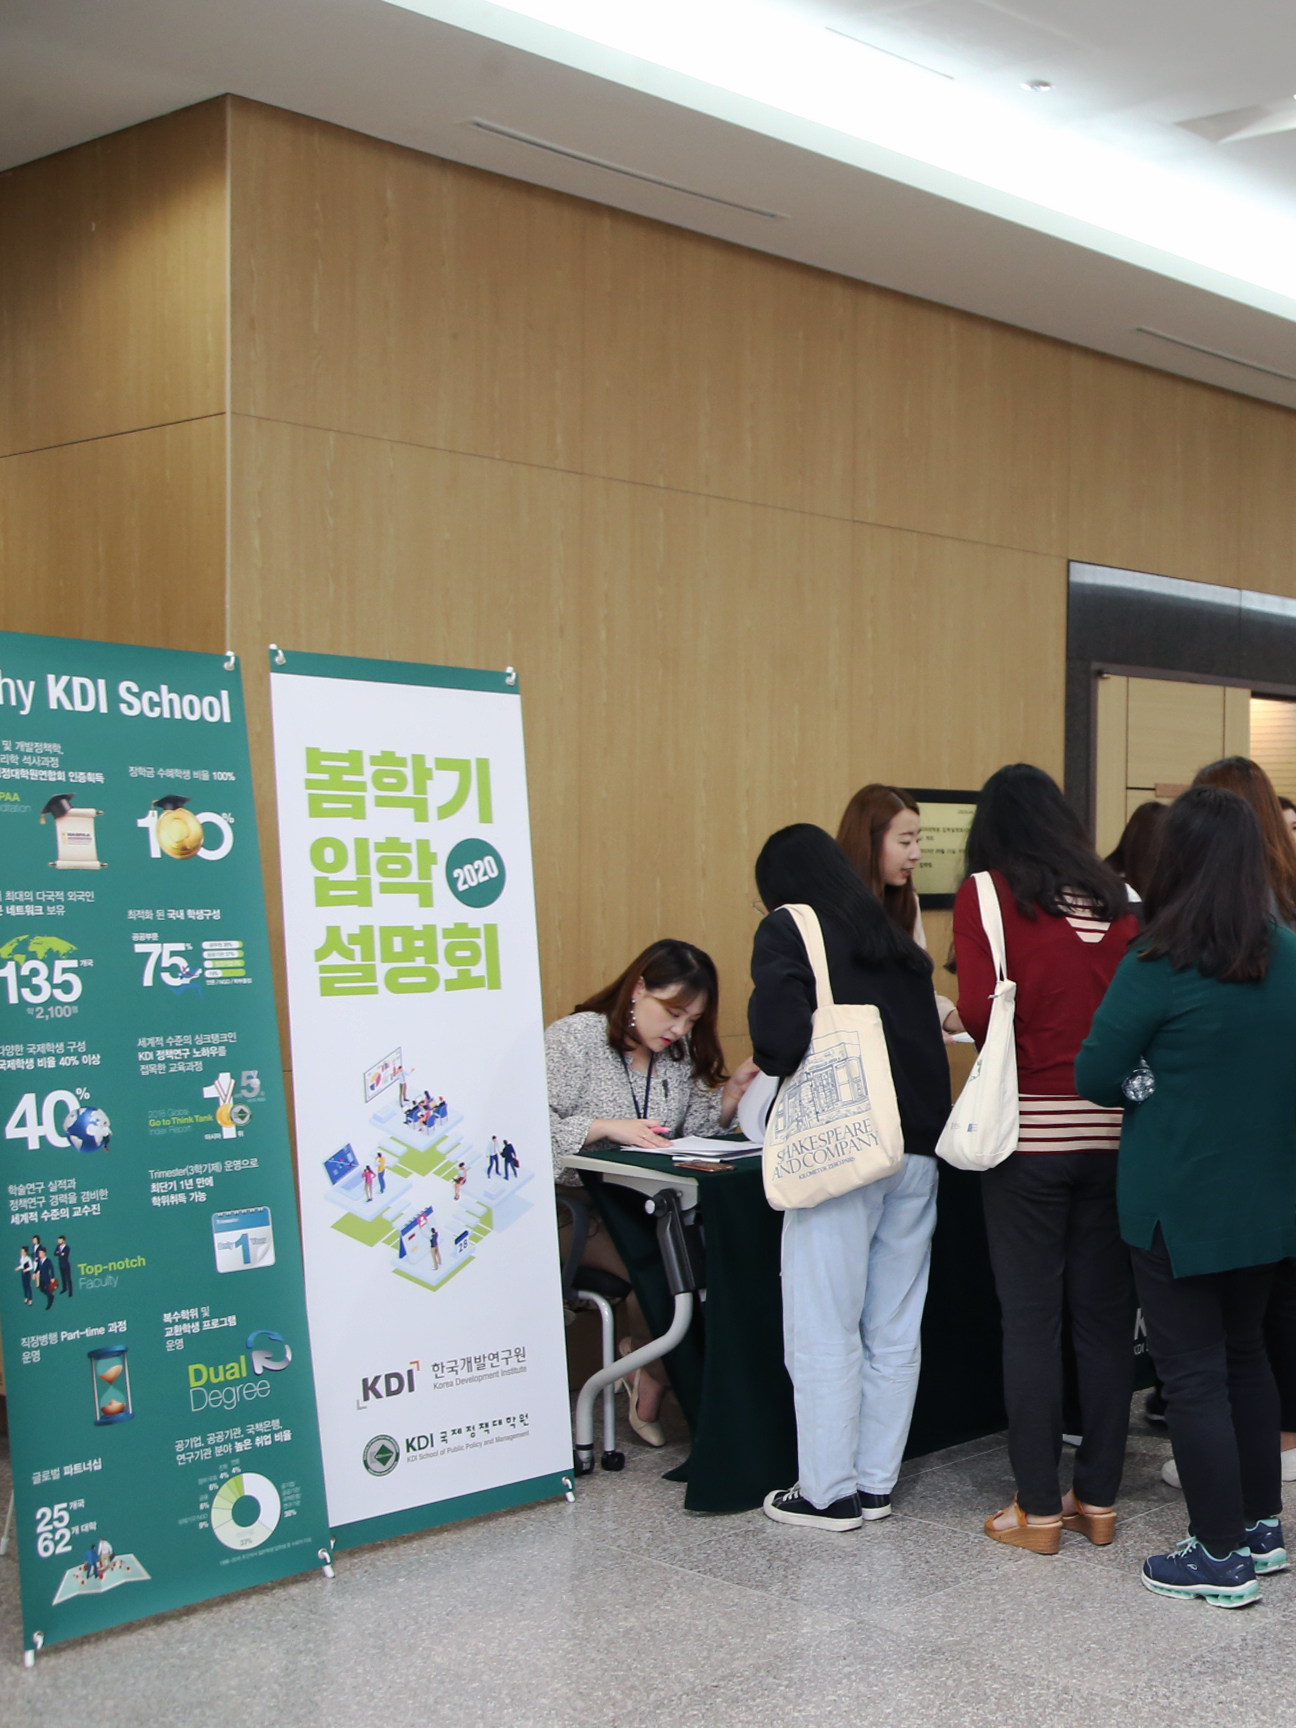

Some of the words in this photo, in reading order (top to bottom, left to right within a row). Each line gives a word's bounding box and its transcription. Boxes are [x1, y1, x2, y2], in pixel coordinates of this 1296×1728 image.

[47, 673, 108, 713] KDI
[118, 680, 231, 723] School
[22, 755, 59, 768] 석사과정
[128, 766, 155, 778] 장학금
[212, 771, 236, 781] 100%
[305, 747, 493, 824] 봄학기
[309, 837, 438, 908] 입학
[452, 855, 499, 892] 2020
[36, 890, 65, 902] 다국적
[67, 890, 95, 902] 외국인
[6, 904, 44, 916] 네트워크
[46, 904, 66, 916] 보유
[167, 909, 185, 920] 국내
[186, 909, 221, 920] 학생구성
[314, 922, 502, 997] 설명회
[26, 1042, 65, 1055] 국제학생
[67, 1041, 86, 1052] 구성
[166, 1034, 192, 1047] 수준의
[37, 1056, 56, 1068] 비율
[59, 1055, 80, 1067] 40%
[81, 1054, 101, 1065] 이상
[138, 1051, 154, 1061] KDI
[168, 1061, 203, 1073] 교육과정
[149, 1119, 161, 1127] Go
[162, 1118, 171, 1126] to
[172, 1116, 194, 1125] Think
[194, 1114, 213, 1122] Tank
[777, 1118, 873, 1165] SHAKESPEARE
[772, 1158, 802, 1181] AND
[802, 1130, 880, 1168] COMPANY
[8, 1181, 45, 1196] 학술연구
[47, 1178, 76, 1192] 실적과
[150, 1180, 177, 1194] 최단기
[179, 1178, 194, 1190] 1년
[9, 1196, 46, 1212] 정책연구
[189, 1191, 207, 1203] 가능
[10, 1211, 38, 1225] 세계적
[41, 1207, 70, 1222] 수준의
[72, 1203, 101, 1218] 교수진
[235, 1232, 251, 1265] 1
[78, 1255, 147, 1276] Top-notch
[79, 1274, 119, 1291] Faculty
[60, 1326, 105, 1342] Part-time
[107, 1320, 127, 1333] 과정
[166, 1338, 184, 1352] 운영
[22, 1350, 41, 1364] 운영
[188, 1355, 247, 1388] Dual
[361, 1367, 416, 1402] KDI
[431, 1346, 527, 1380] 한국개발연구원
[433, 1380, 454, 1391] Korea
[455, 1371, 499, 1387] Development
[500, 1366, 527, 1378] Institute
[190, 1380, 271, 1412] Degree
[405, 1433, 434, 1453] KDI
[406, 1455, 417, 1463] KDI
[418, 1450, 439, 1461] School
[440, 1448, 446, 1456] of
[446, 1445, 464, 1454] Public
[465, 1442, 483, 1450] Policy
[484, 1438, 494, 1446] and
[495, 1430, 530, 1443] Management
[176, 1449, 212, 1466] 연구기관
[214, 1443, 233, 1457] 분야
[32, 1467, 60, 1485] 글로벌
[63, 1458, 102, 1476] 파트너십
